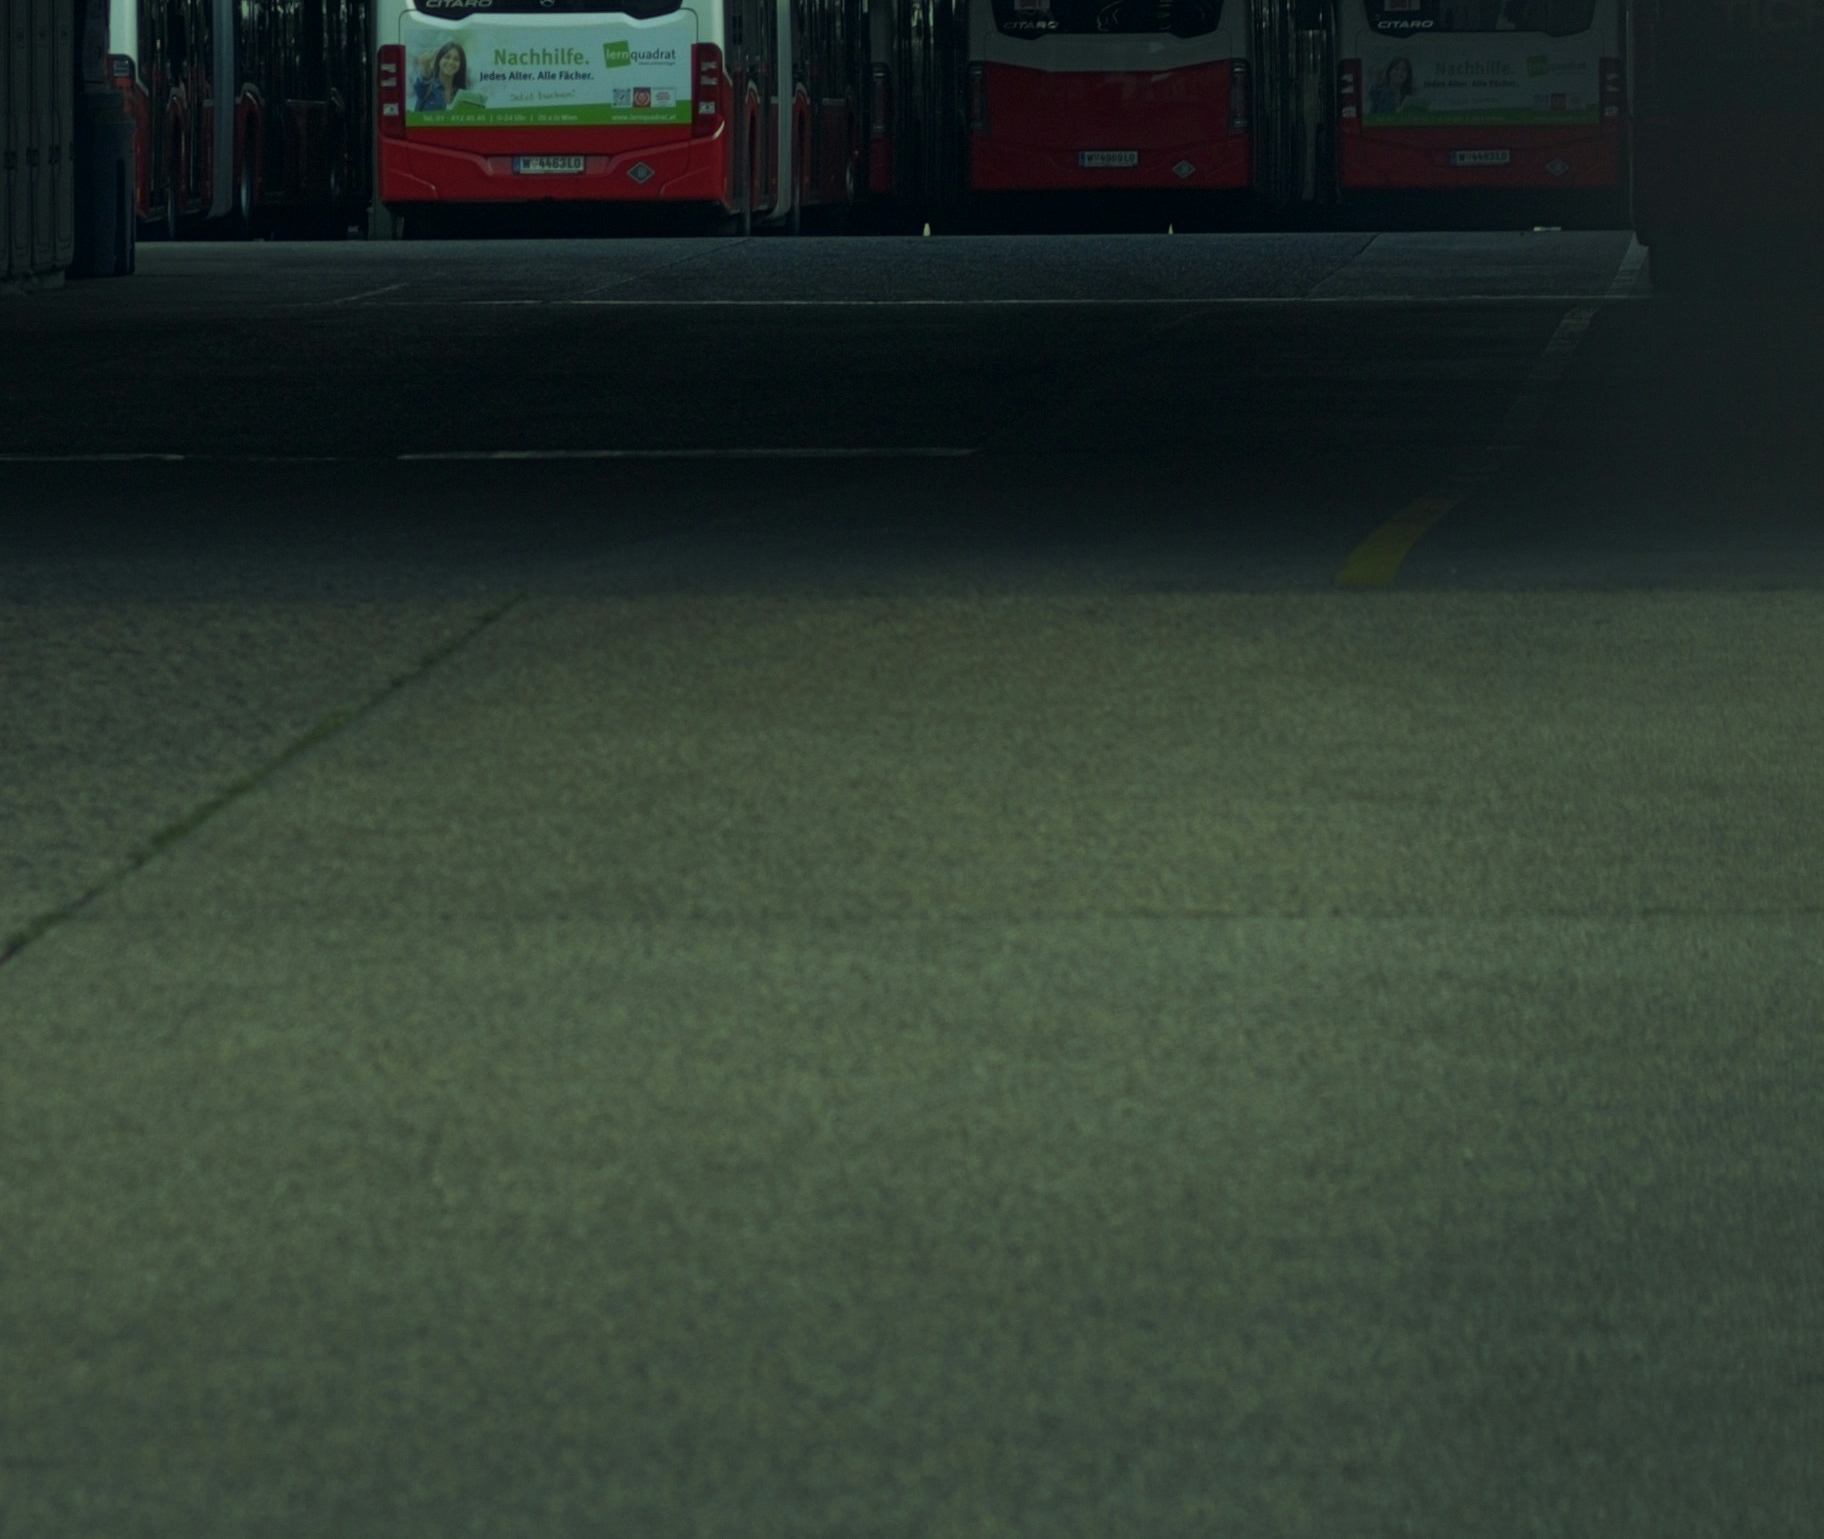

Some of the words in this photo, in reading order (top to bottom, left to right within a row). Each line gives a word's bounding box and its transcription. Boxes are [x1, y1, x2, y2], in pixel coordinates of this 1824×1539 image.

[1003, 20, 1059, 30] CITARO
[1377, 20, 1434, 29] CITARO
[494, 48, 590, 66] Nachhilfe.
[1435, 60, 1515, 76] Nachhilfe.
[480, 71, 506, 81] Jedes
[508, 70, 535, 81] Alter.
[537, 70, 557, 81] Alle
[559, 70, 595, 81] Fächer.
